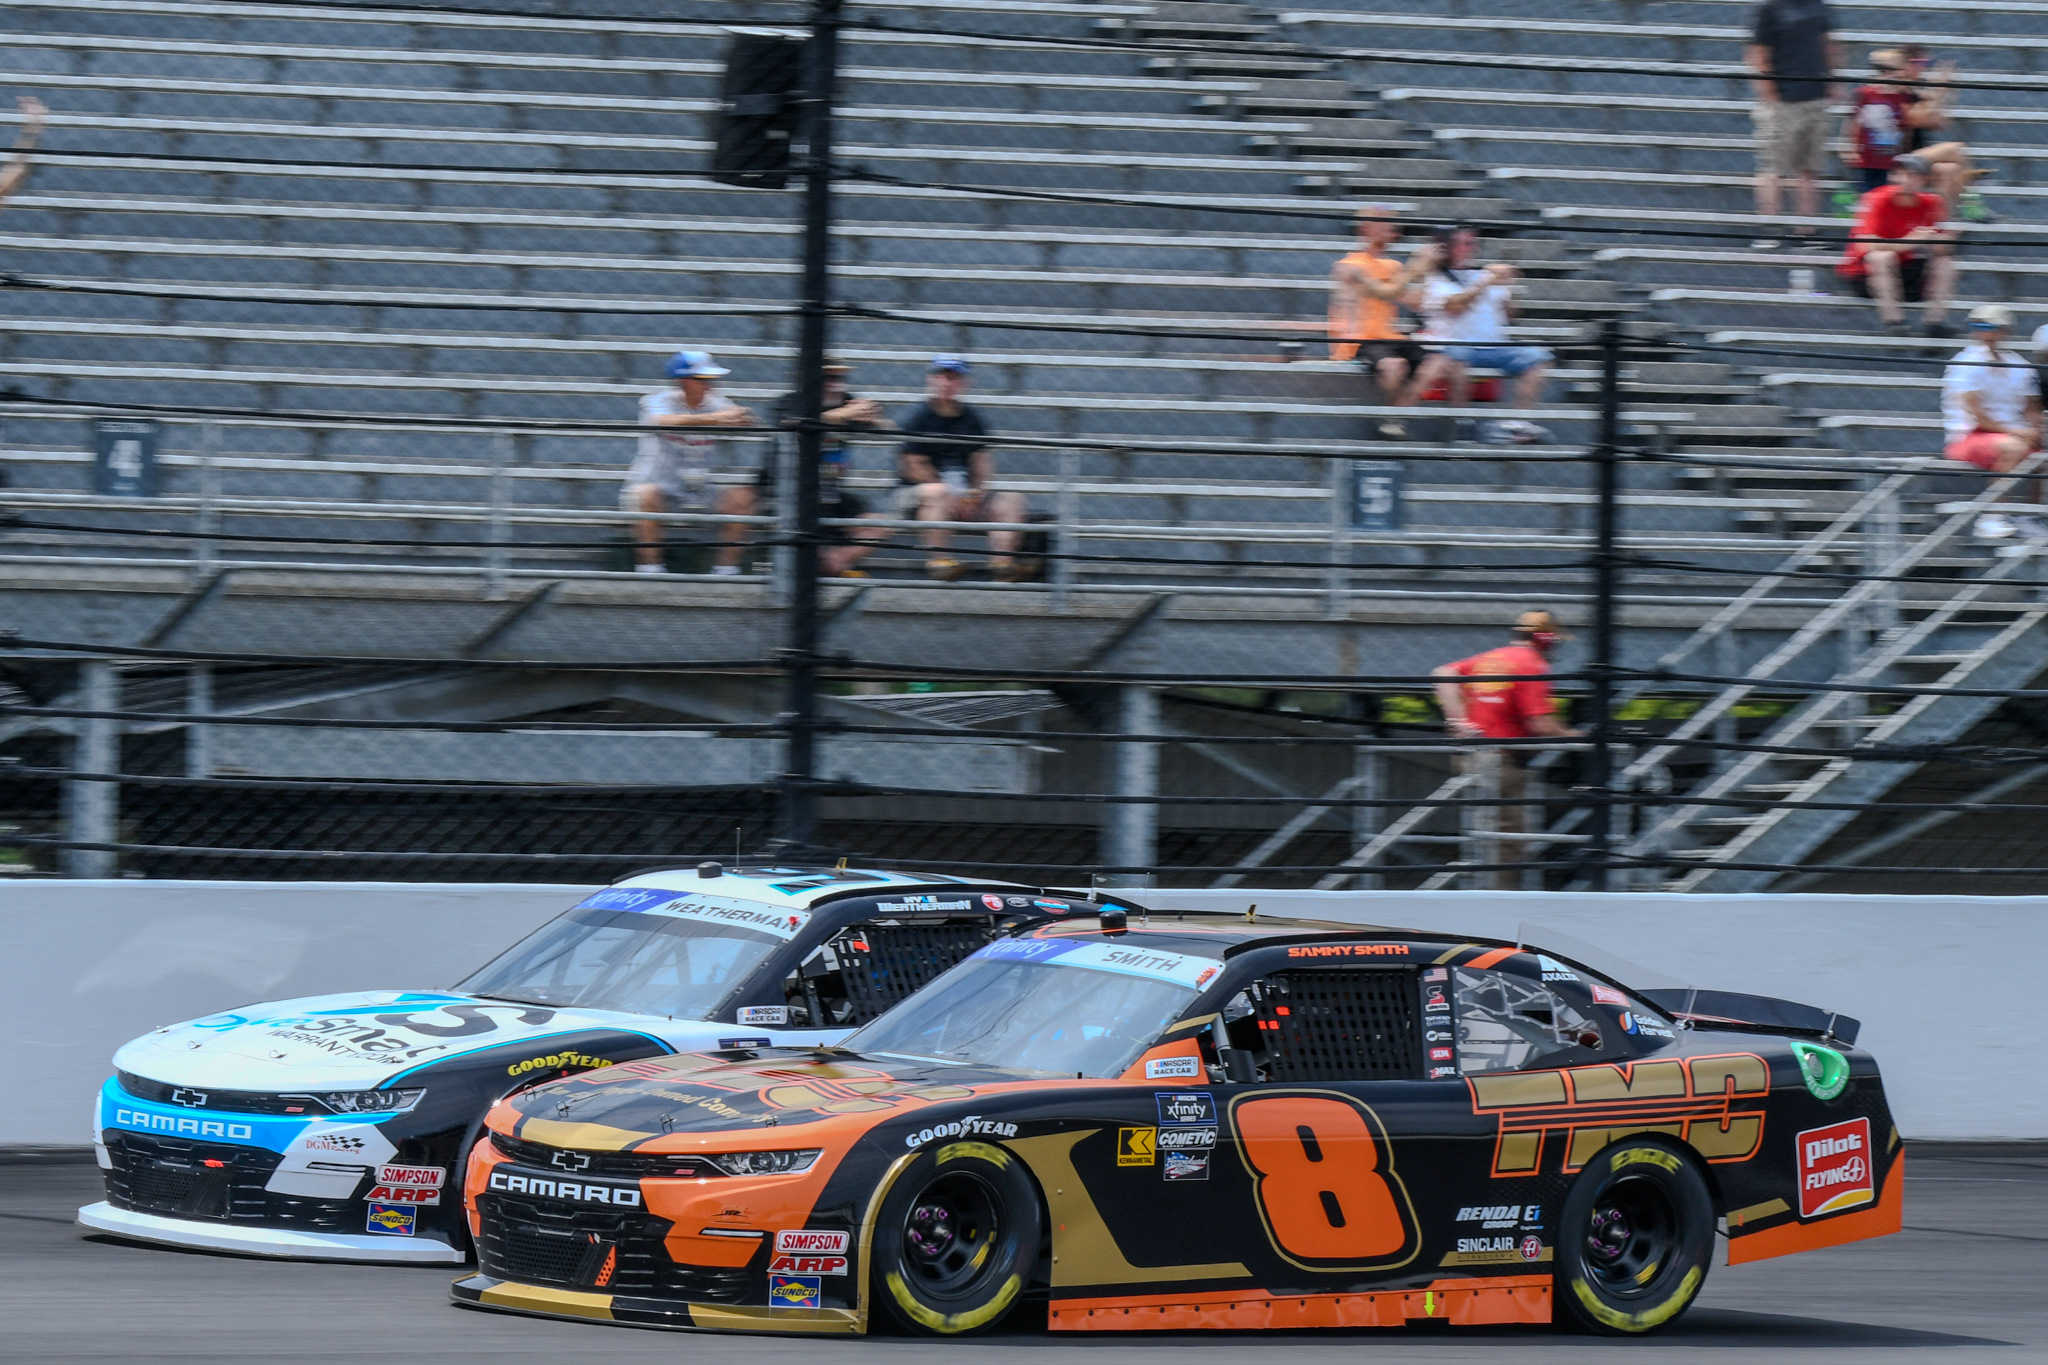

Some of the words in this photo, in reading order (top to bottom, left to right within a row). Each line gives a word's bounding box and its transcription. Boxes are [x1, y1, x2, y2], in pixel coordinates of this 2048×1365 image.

[1360, 476, 1393, 513] 5
[1287, 946, 1353, 957] SAMMY
[1354, 945, 1409, 955] SMITH
[1102, 951, 1182, 972] SMITH
[1541, 972, 1581, 982] AXALTA
[1163, 1059, 1192, 1067] NASCAR
[1167, 1102, 1206, 1119] xfinity
[116, 1108, 252, 1140] CAMARO
[905, 1116, 1018, 1148] GOODYEAR
[306, 1139, 331, 1151] DGM
[1159, 1128, 1216, 1146] COMETIC
[382, 1167, 440, 1185] SIMPSON
[1236, 1097, 1406, 1258] 8
[1805, 1165, 1850, 1190] FLYING
[368, 1186, 438, 1202] ARP
[490, 1172, 641, 1207] CAMARO
[372, 1214, 412, 1224] SUNOCO
[1455, 1205, 1521, 1221] RENDA
[1482, 1220, 1518, 1229] GROUP
[782, 1234, 843, 1250] SIMPSON
[1457, 1236, 1514, 1253] SINCLAIR
[771, 1257, 846, 1272] ARP
[774, 1287, 816, 1296] SUNOCO
